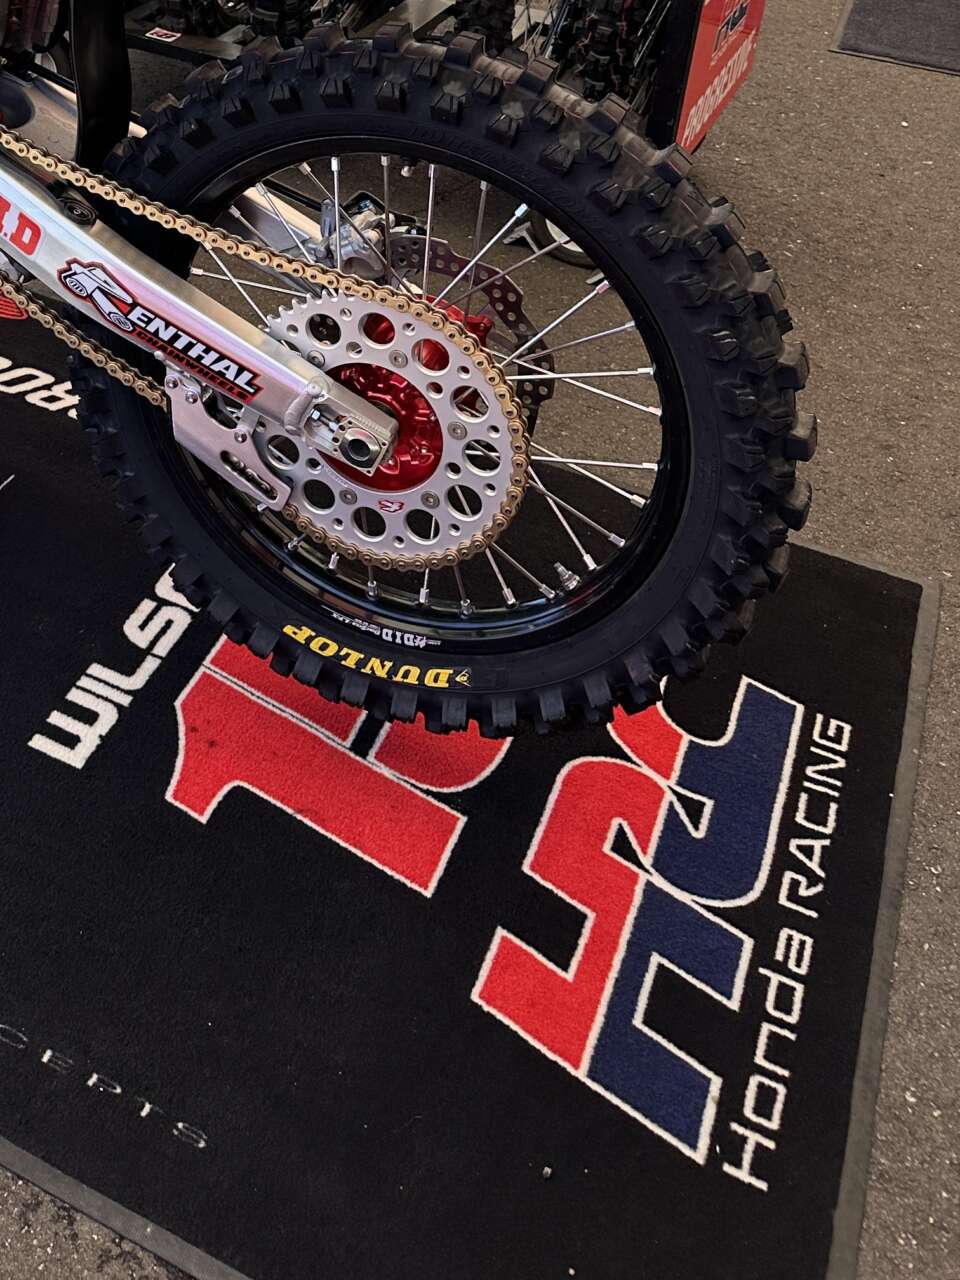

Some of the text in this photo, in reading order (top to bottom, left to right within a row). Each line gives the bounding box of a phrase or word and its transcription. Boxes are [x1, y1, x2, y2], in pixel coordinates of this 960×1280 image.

[136, 326, 252, 401] CHAINWHEELS
[27, 562, 201, 770] WILS
[282, 624, 454, 688] DUNLOP
[777, 712, 854, 918] RACING
